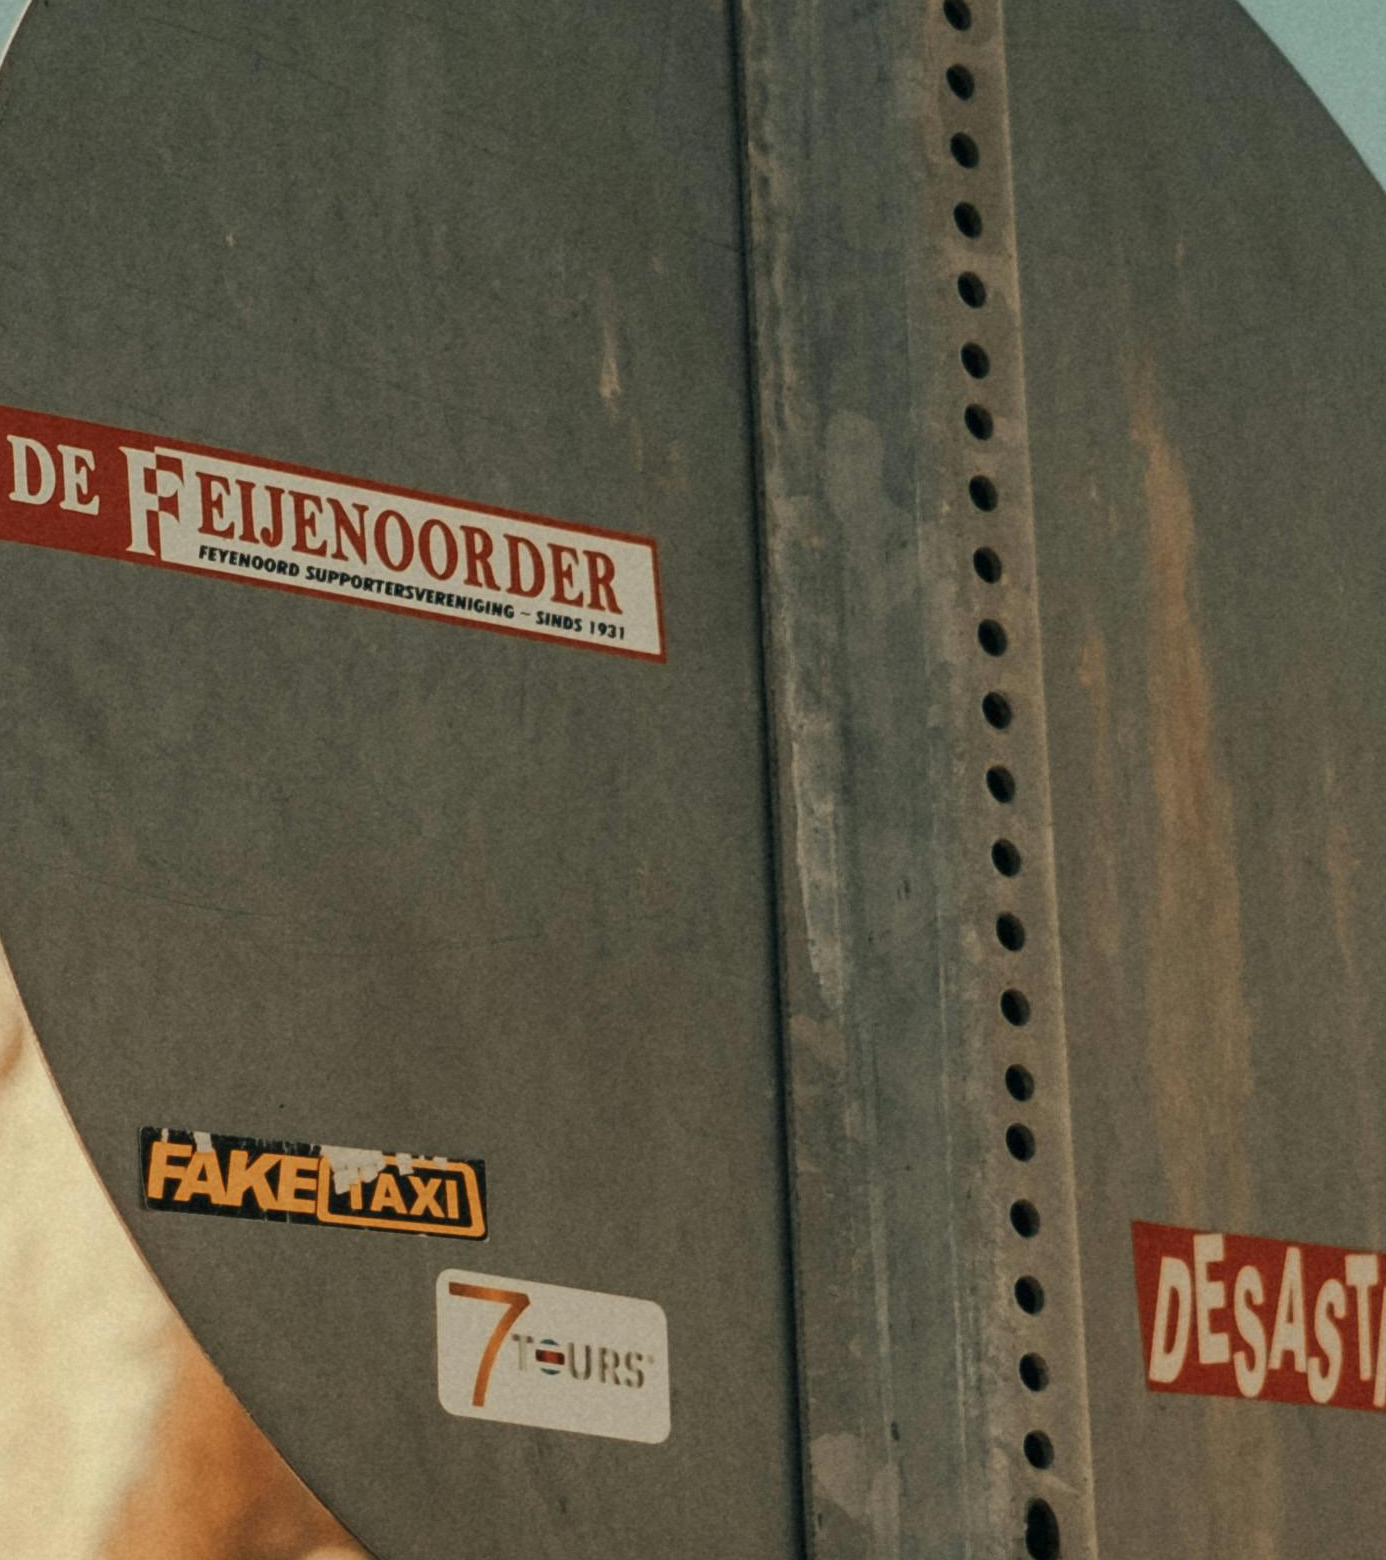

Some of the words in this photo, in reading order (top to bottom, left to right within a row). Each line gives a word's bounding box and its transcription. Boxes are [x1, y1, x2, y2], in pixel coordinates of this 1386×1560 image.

[7, 434, 100, 516] DE
[117, 445, 623, 614] FEIJENOORDER
[198, 545, 300, 577] FEYENOORD
[305, 565, 515, 619] SUPPORTERSVERENIGING
[536, 610, 583, 632] SINDS
[589, 621, 625, 640] 1931
[148, 1141, 319, 1214] FAKE
